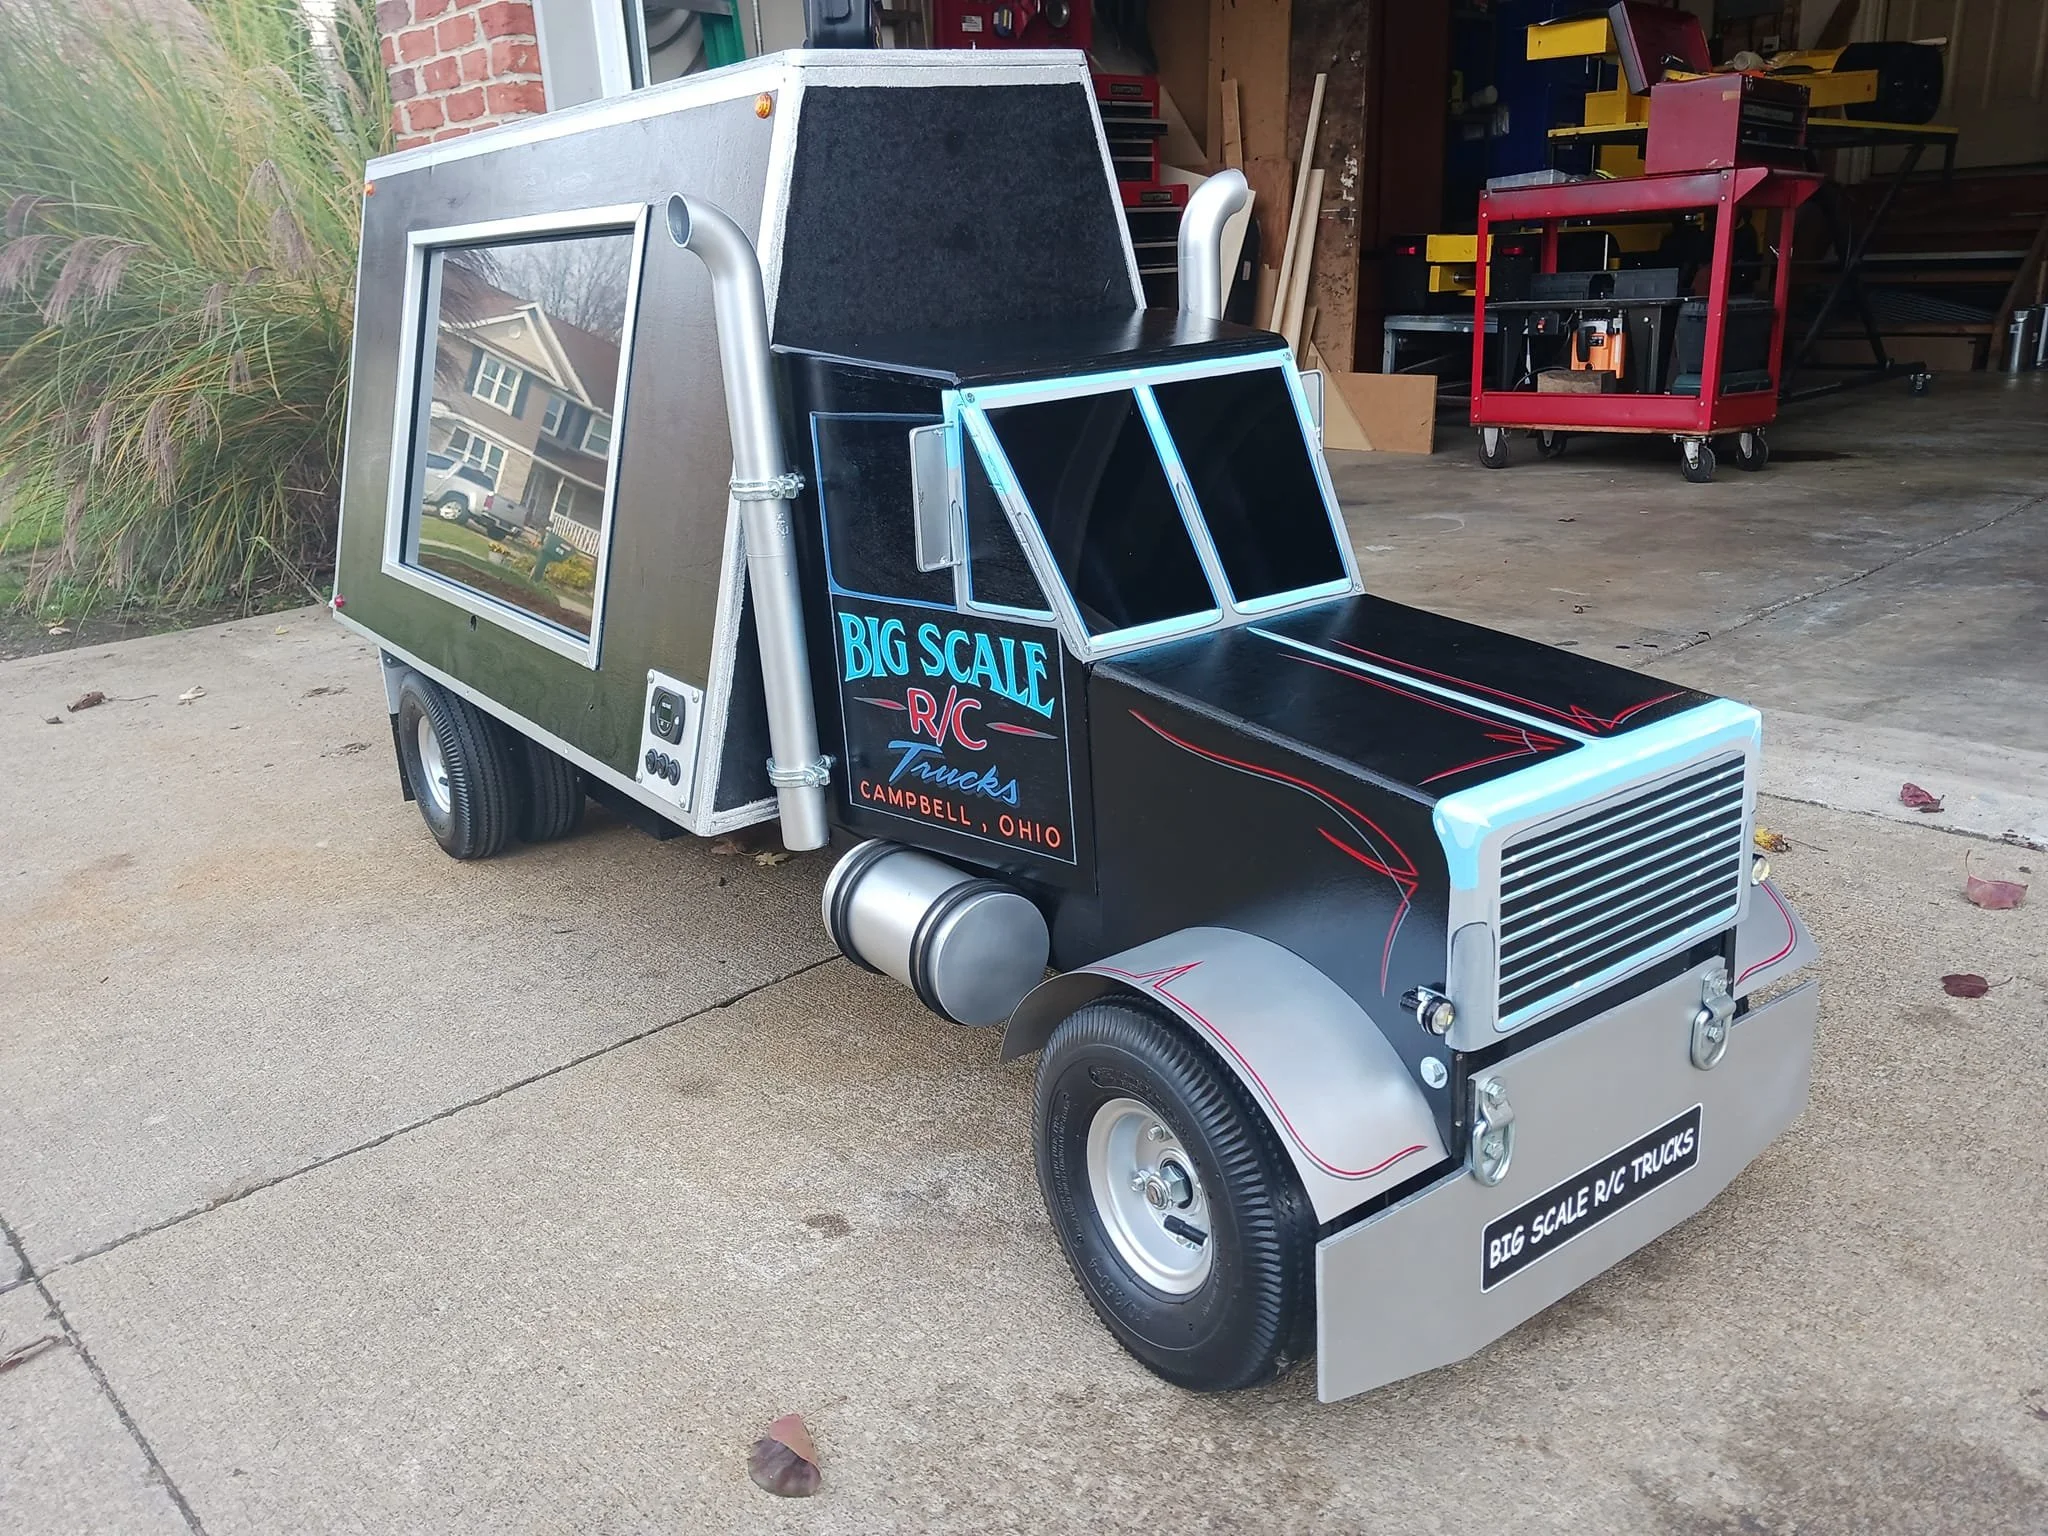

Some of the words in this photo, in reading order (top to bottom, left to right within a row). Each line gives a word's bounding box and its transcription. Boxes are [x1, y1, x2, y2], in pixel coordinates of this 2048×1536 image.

[838, 612, 910, 682] BIG
[918, 623, 1055, 719] SCALE
[907, 685, 988, 750] R/C
[888, 740, 1020, 806] Trucks
[999, 814, 1061, 848] OHIO
[1489, 1225, 1525, 1269] BIG
[1530, 1186, 1589, 1244] SCALE
[1594, 1166, 1626, 1207] R/C
[1630, 1128, 1694, 1183] TRUCKS
